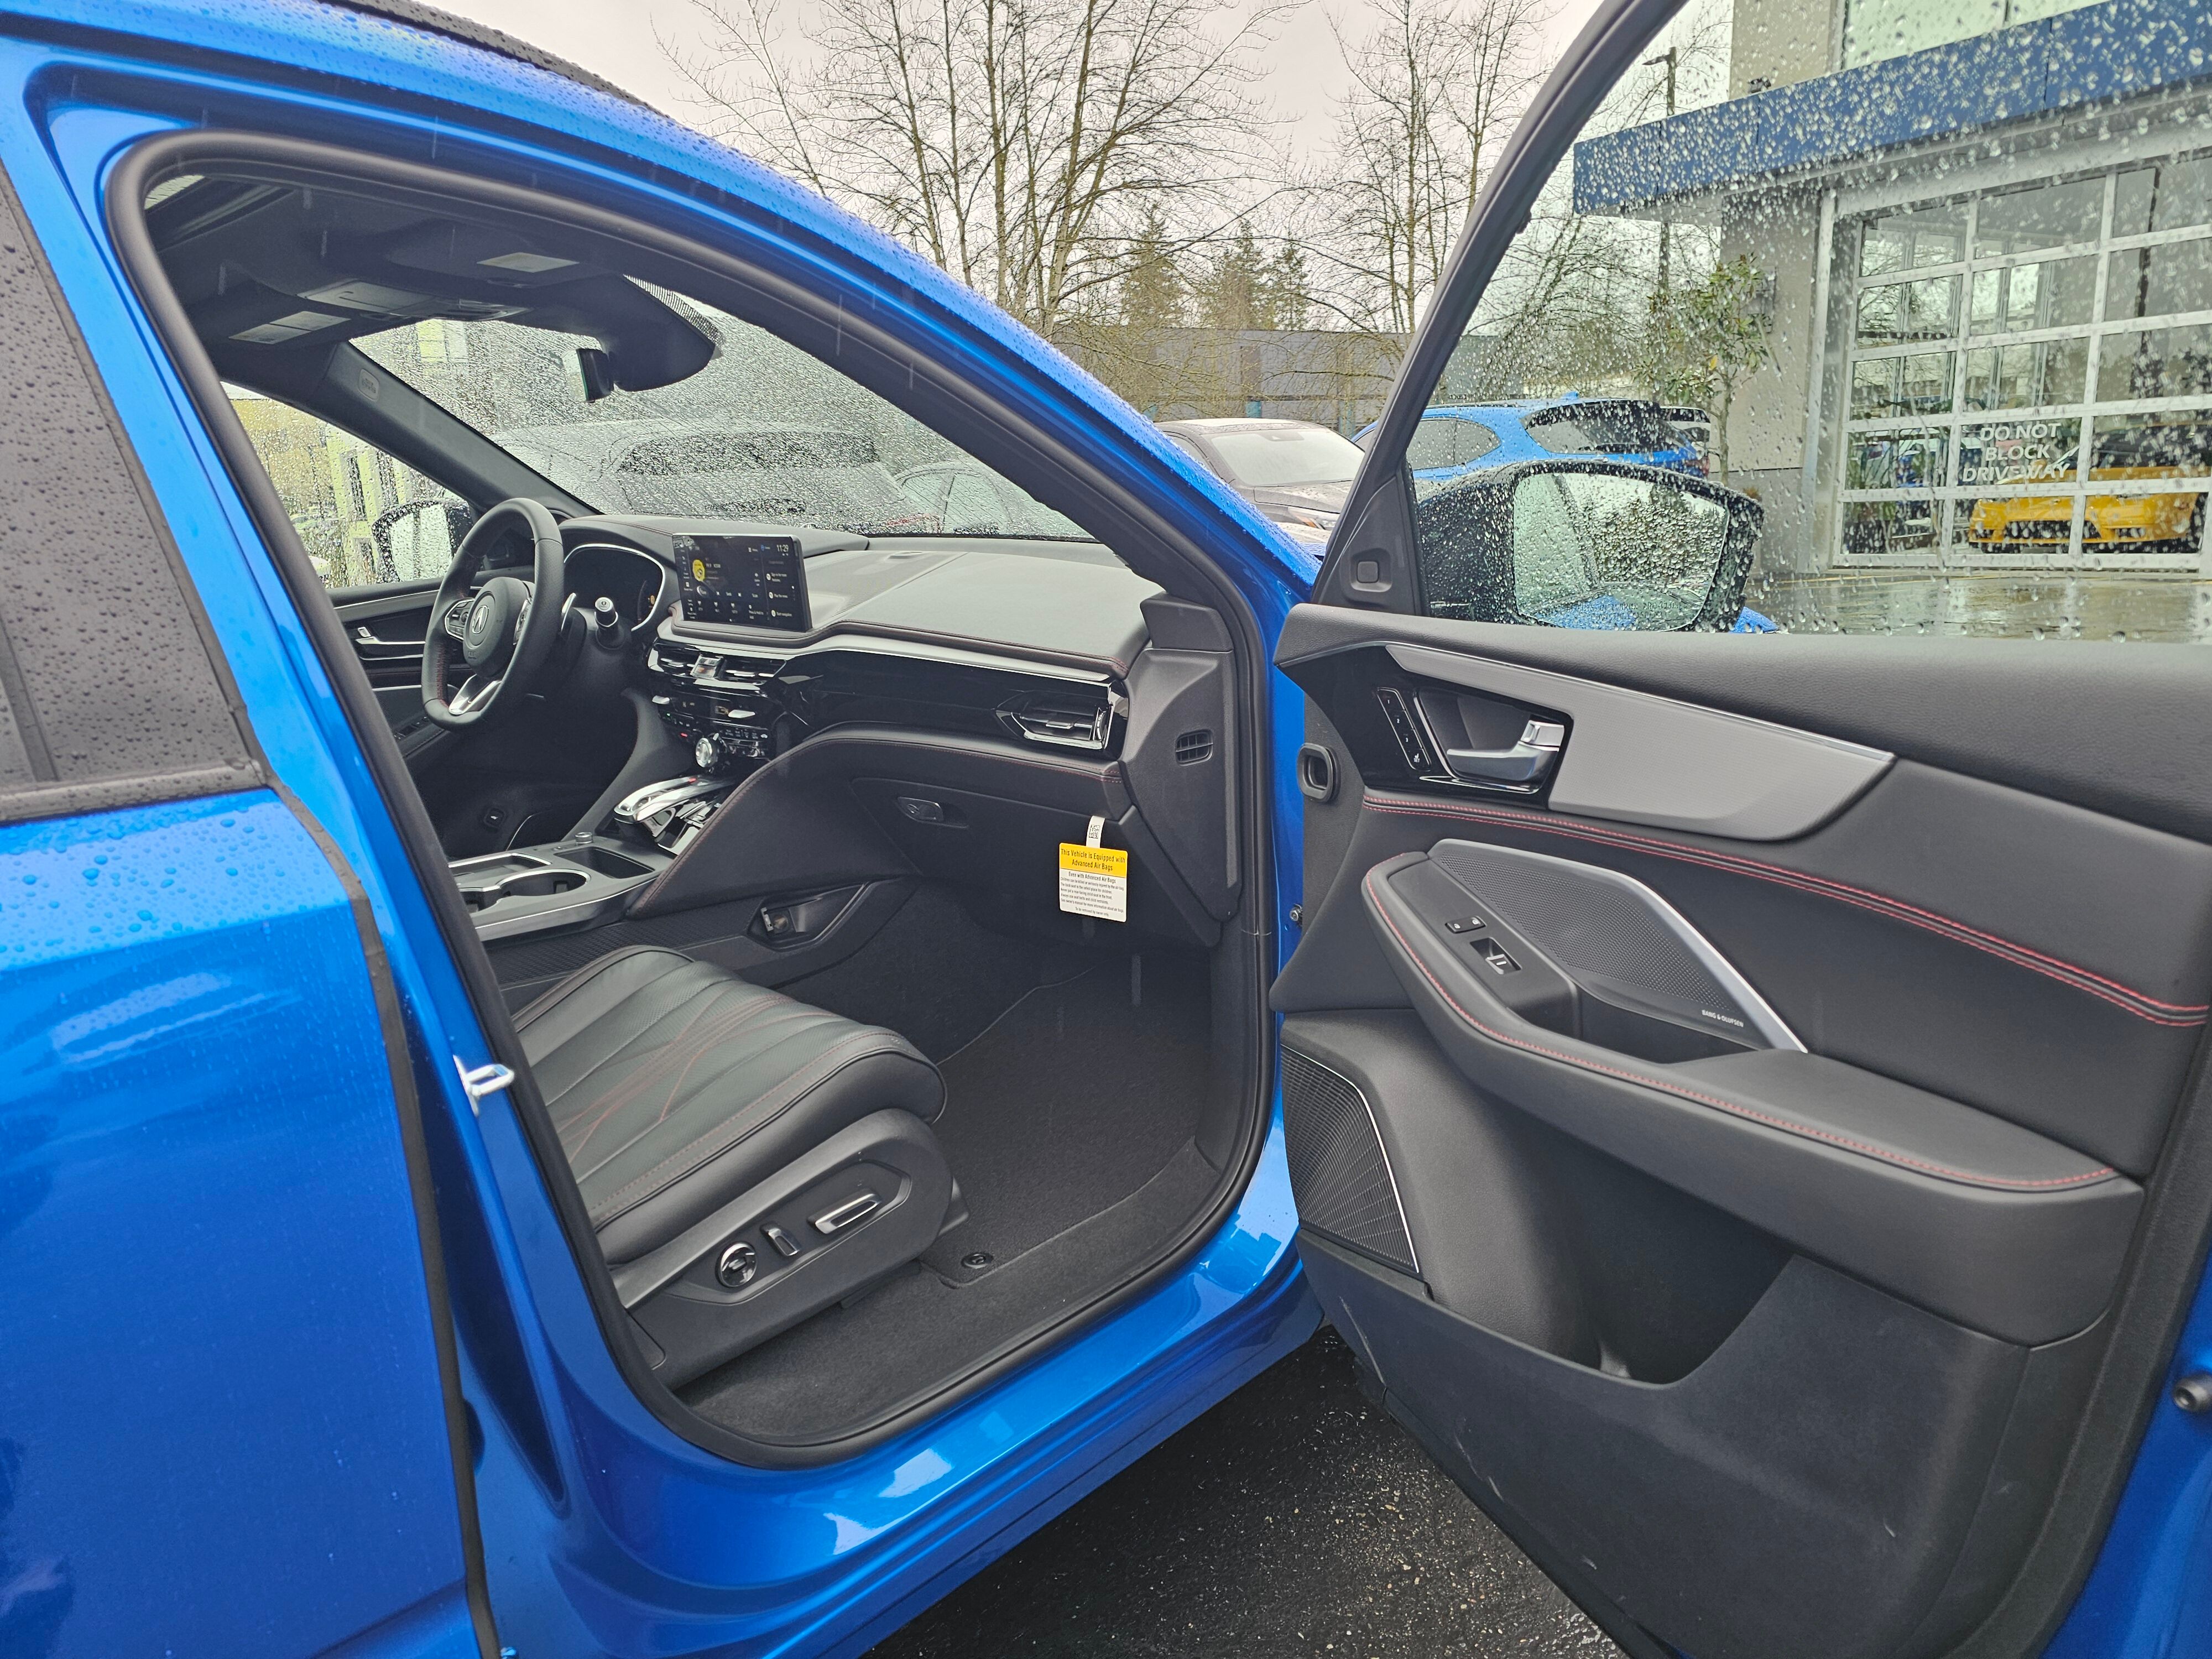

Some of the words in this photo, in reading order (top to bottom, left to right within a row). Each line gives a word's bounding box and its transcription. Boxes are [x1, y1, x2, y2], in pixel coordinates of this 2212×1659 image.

[1980, 426, 2010, 441] DO
[2015, 422, 2062, 439] NOT
[1985, 444, 2051, 461] BLOCK
[1963, 462, 2070, 482] DRIVEWAY
[1071, 849, 1087, 858] Vehicle
[1093, 853, 1114, 862] Equipped
[1072, 859, 1093, 868] Advanced
[1102, 863, 1113, 872] Bags
[1702, 1009, 1716, 1019] BANG
[1721, 1015, 1744, 1027] OLUFSEN
